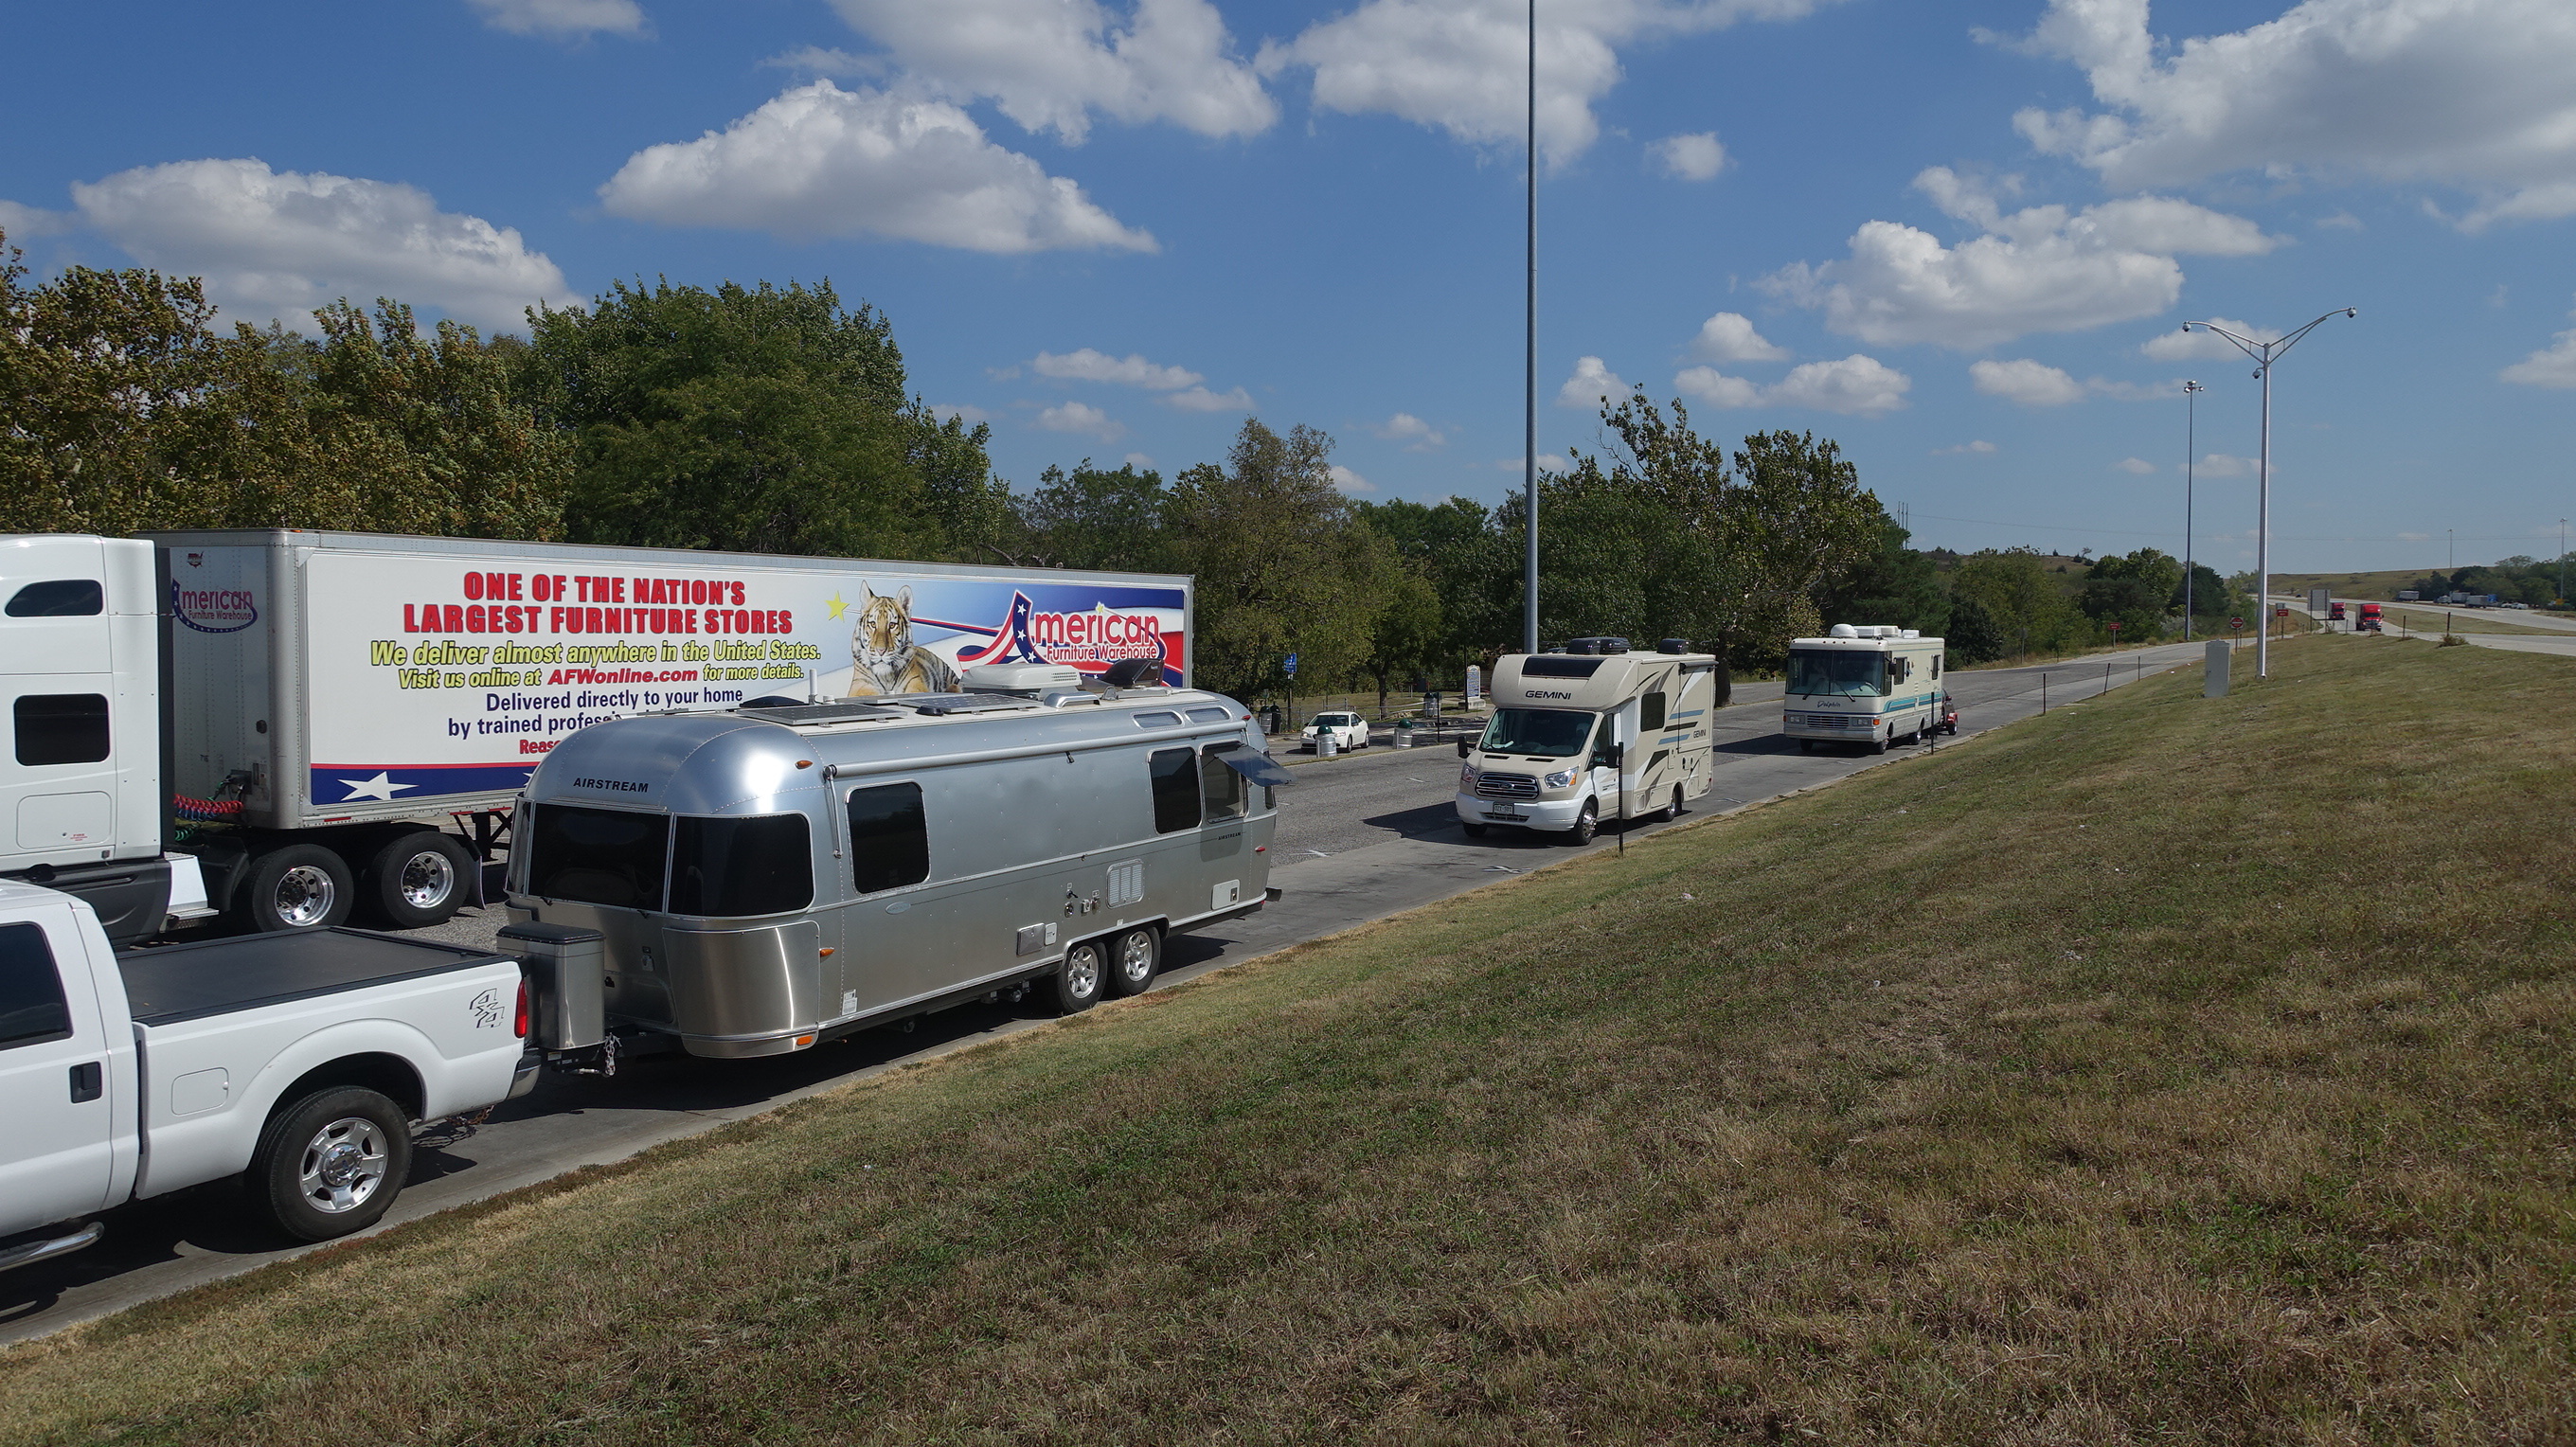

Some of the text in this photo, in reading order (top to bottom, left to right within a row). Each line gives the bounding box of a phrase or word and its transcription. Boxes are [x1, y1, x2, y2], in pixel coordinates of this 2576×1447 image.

[464, 572, 745, 606] ONE OF THE NATION'S
[189, 610, 252, 620] Furniture Warehouse
[403, 604, 793, 634] LARGEST FURNITURE STORES
[371, 639, 821, 668] We deliver almost anywhere in the United States.
[1046, 644, 1157, 660] Furniture Warehouse
[399, 663, 804, 689] Visit us online at AFWonline.com for more details.
[487, 687, 742, 711] Delivered directly to your home
[1526, 690, 1572, 700] GEMINI
[448, 718, 472, 741] by
[477, 715, 542, 736] trained
[573, 777, 649, 793] AIRSTREAM
